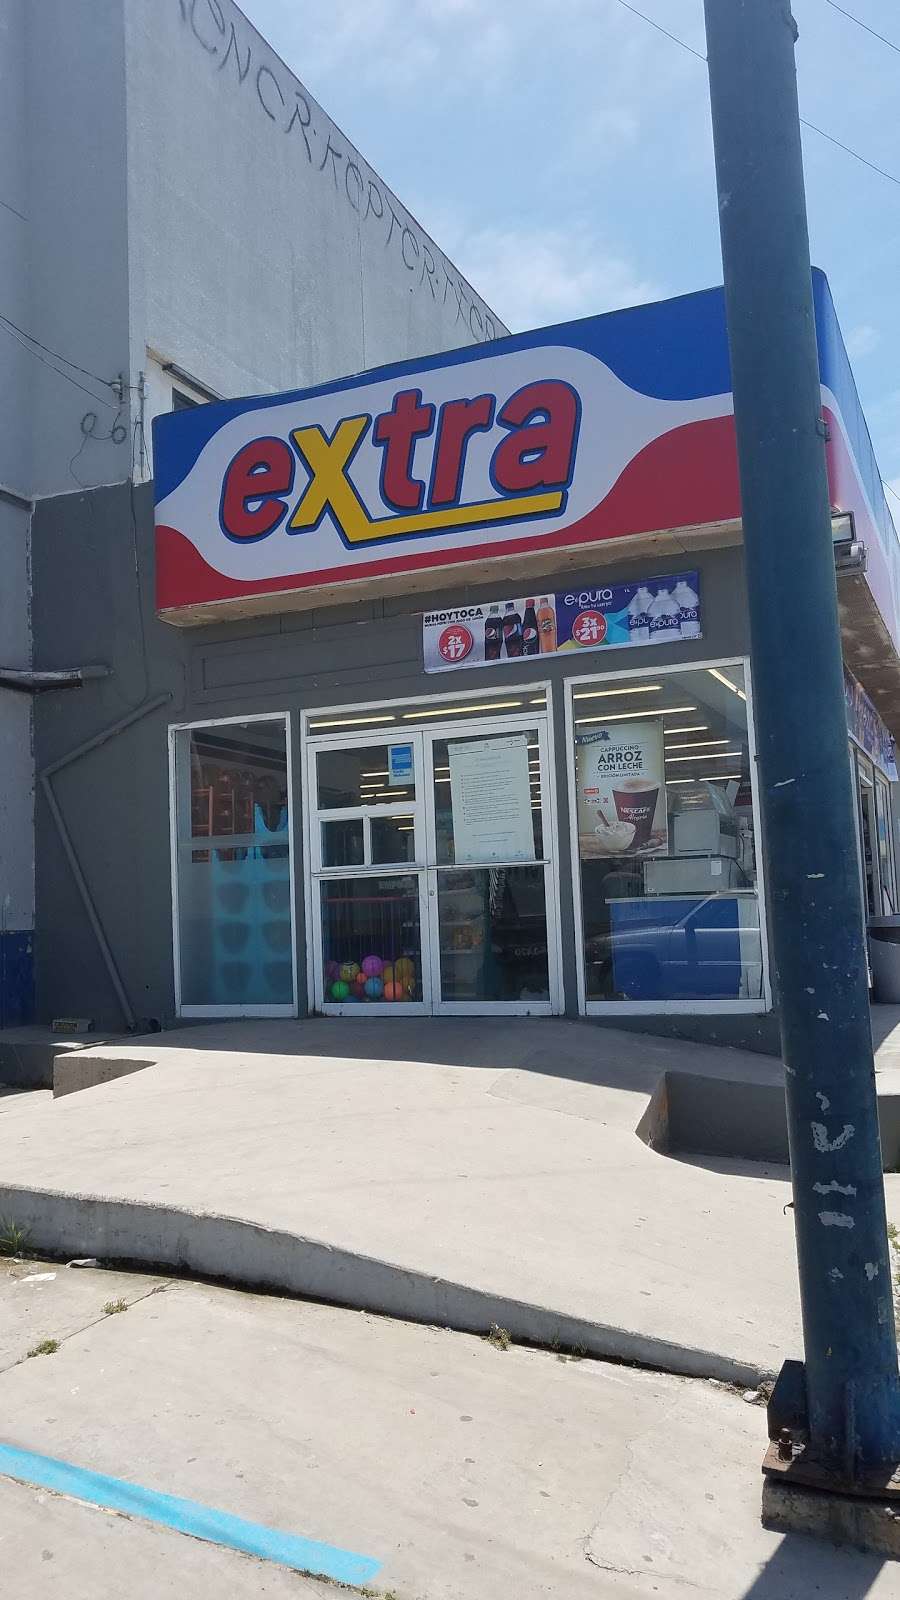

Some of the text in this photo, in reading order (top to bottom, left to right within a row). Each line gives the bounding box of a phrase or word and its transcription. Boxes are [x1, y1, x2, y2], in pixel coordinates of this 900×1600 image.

[219, 379, 582, 549] extra
[424, 607, 484, 623] #HOYTOCA
[442, 643, 466, 658] $17
[598, 751, 643, 763] ARROZ
[597, 761, 643, 772] CON LECHE
